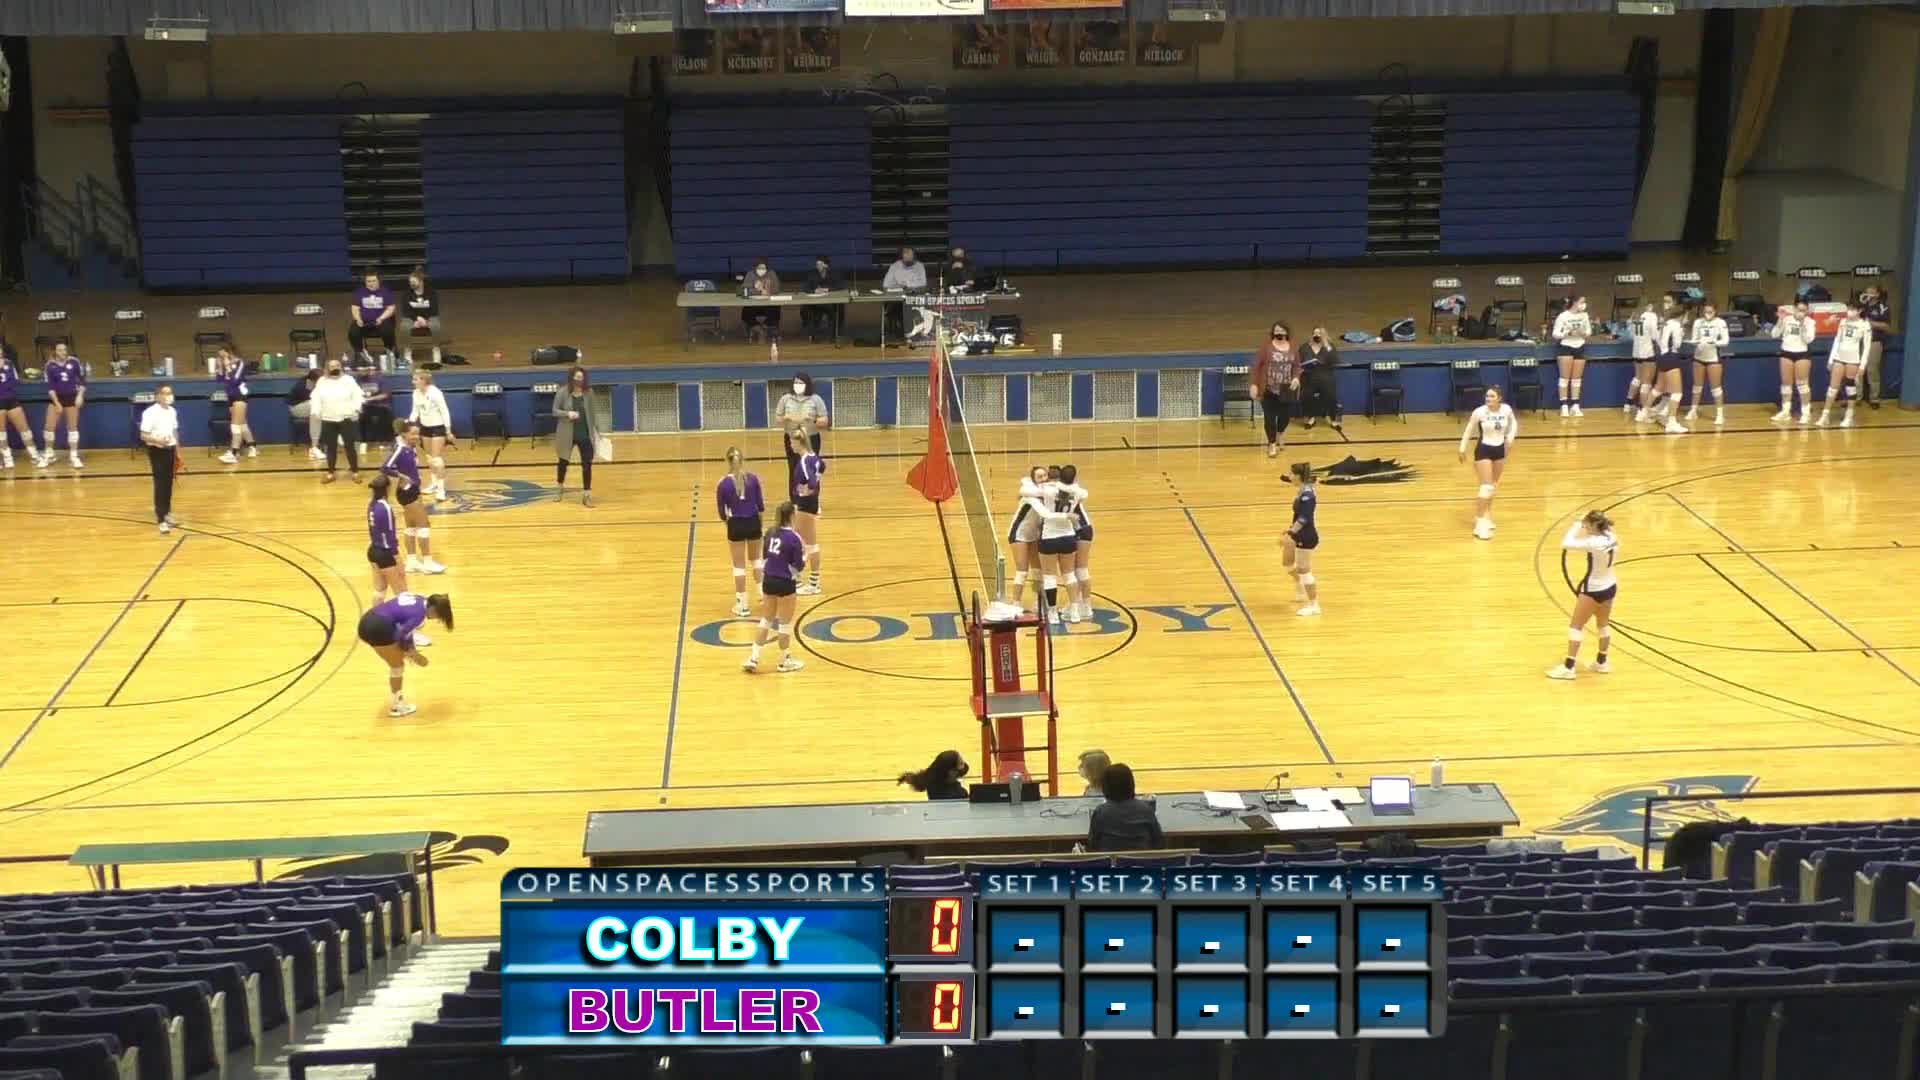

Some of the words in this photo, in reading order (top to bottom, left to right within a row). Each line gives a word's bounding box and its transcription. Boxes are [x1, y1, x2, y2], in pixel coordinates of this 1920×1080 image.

[906, 296, 925, 305] OPEN
[927, 296, 955, 305] SPACES
[957, 295, 985, 305] SPORTS
[768, 537, 781, 554] 12
[690, 603, 1236, 647] COLBY
